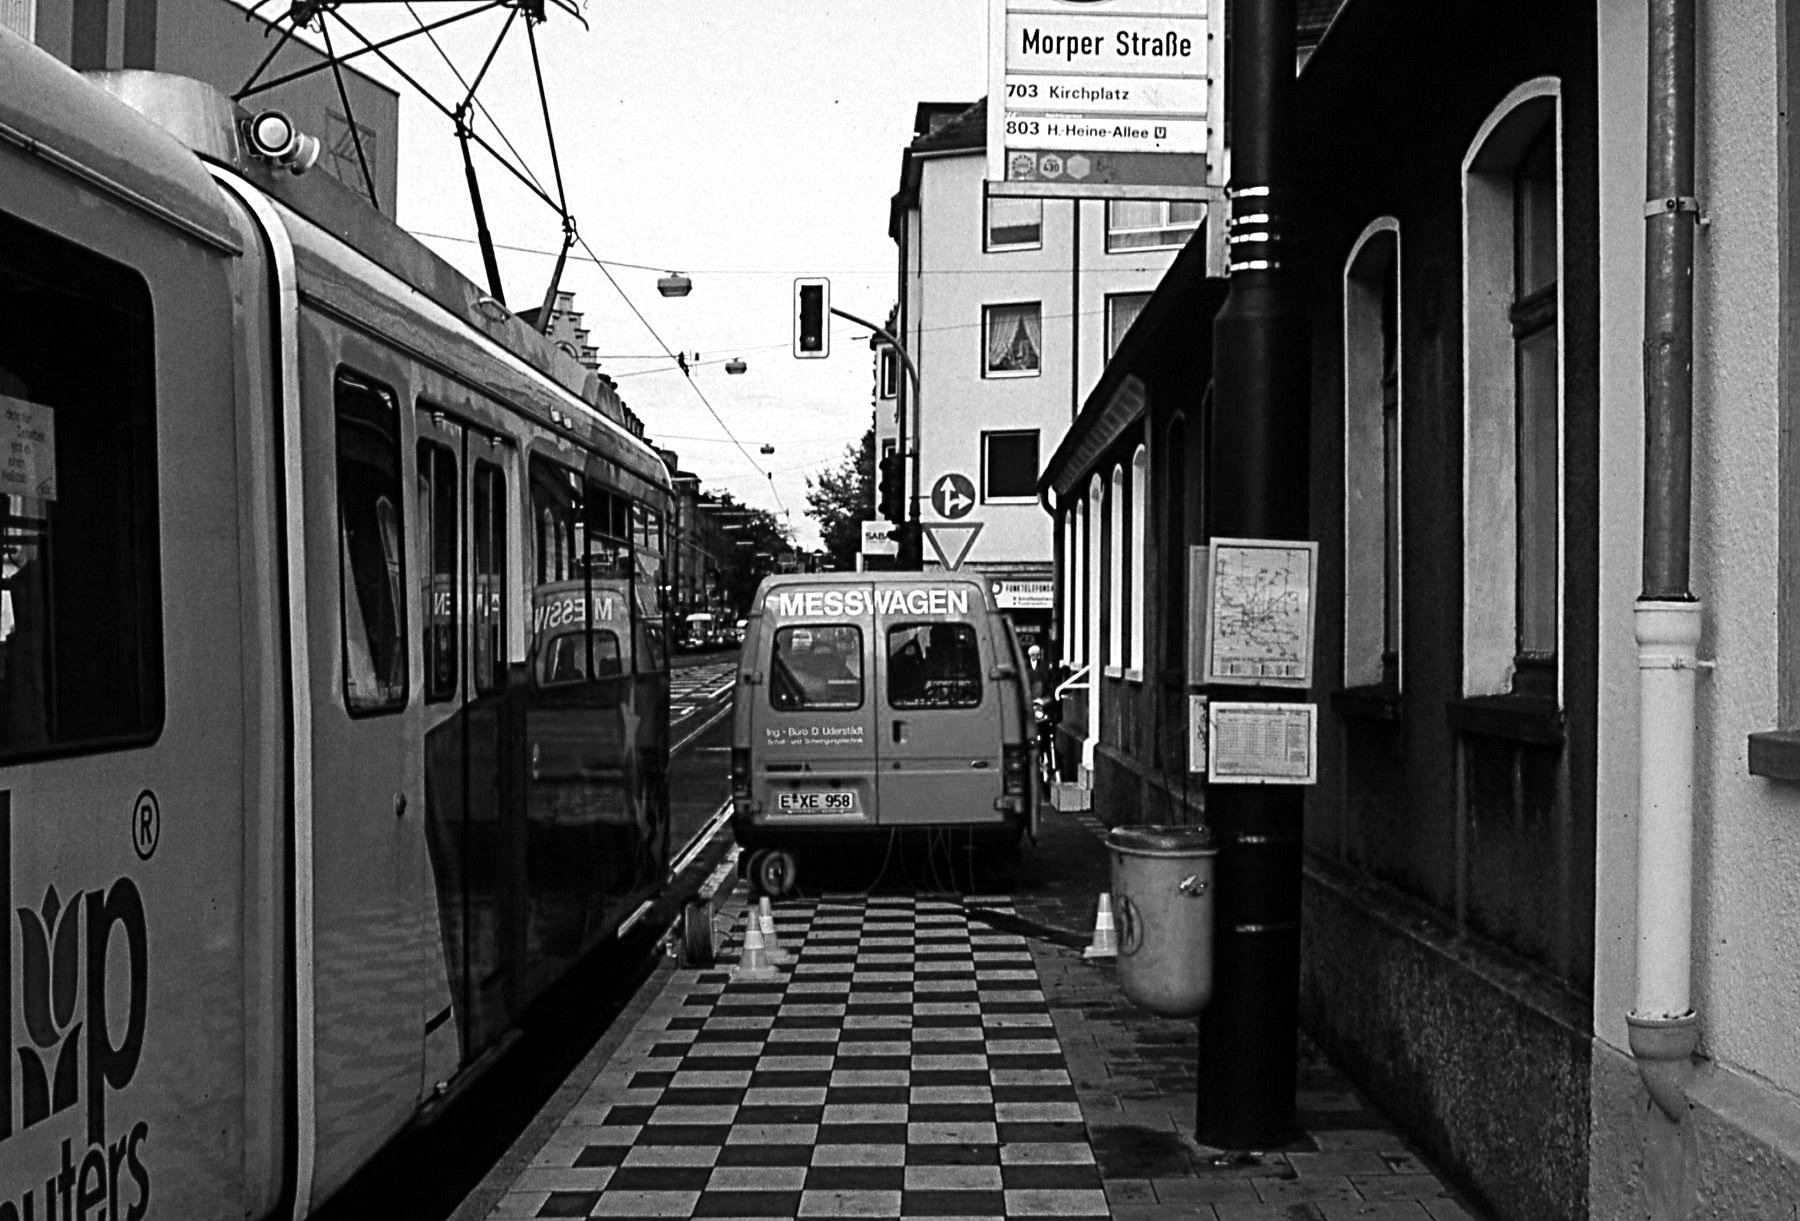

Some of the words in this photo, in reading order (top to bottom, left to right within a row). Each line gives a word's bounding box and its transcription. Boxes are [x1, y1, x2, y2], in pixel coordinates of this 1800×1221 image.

[1022, 28, 1104, 61] Morper
[1116, 31, 1191, 57] Straße
[1006, 84, 1038, 98] 703
[1050, 86, 1129, 101] Kirchplatz
[1006, 121, 1040, 135] 803
[780, 590, 968, 616] MESSWAGEN
[825, 794, 850, 807] 958
